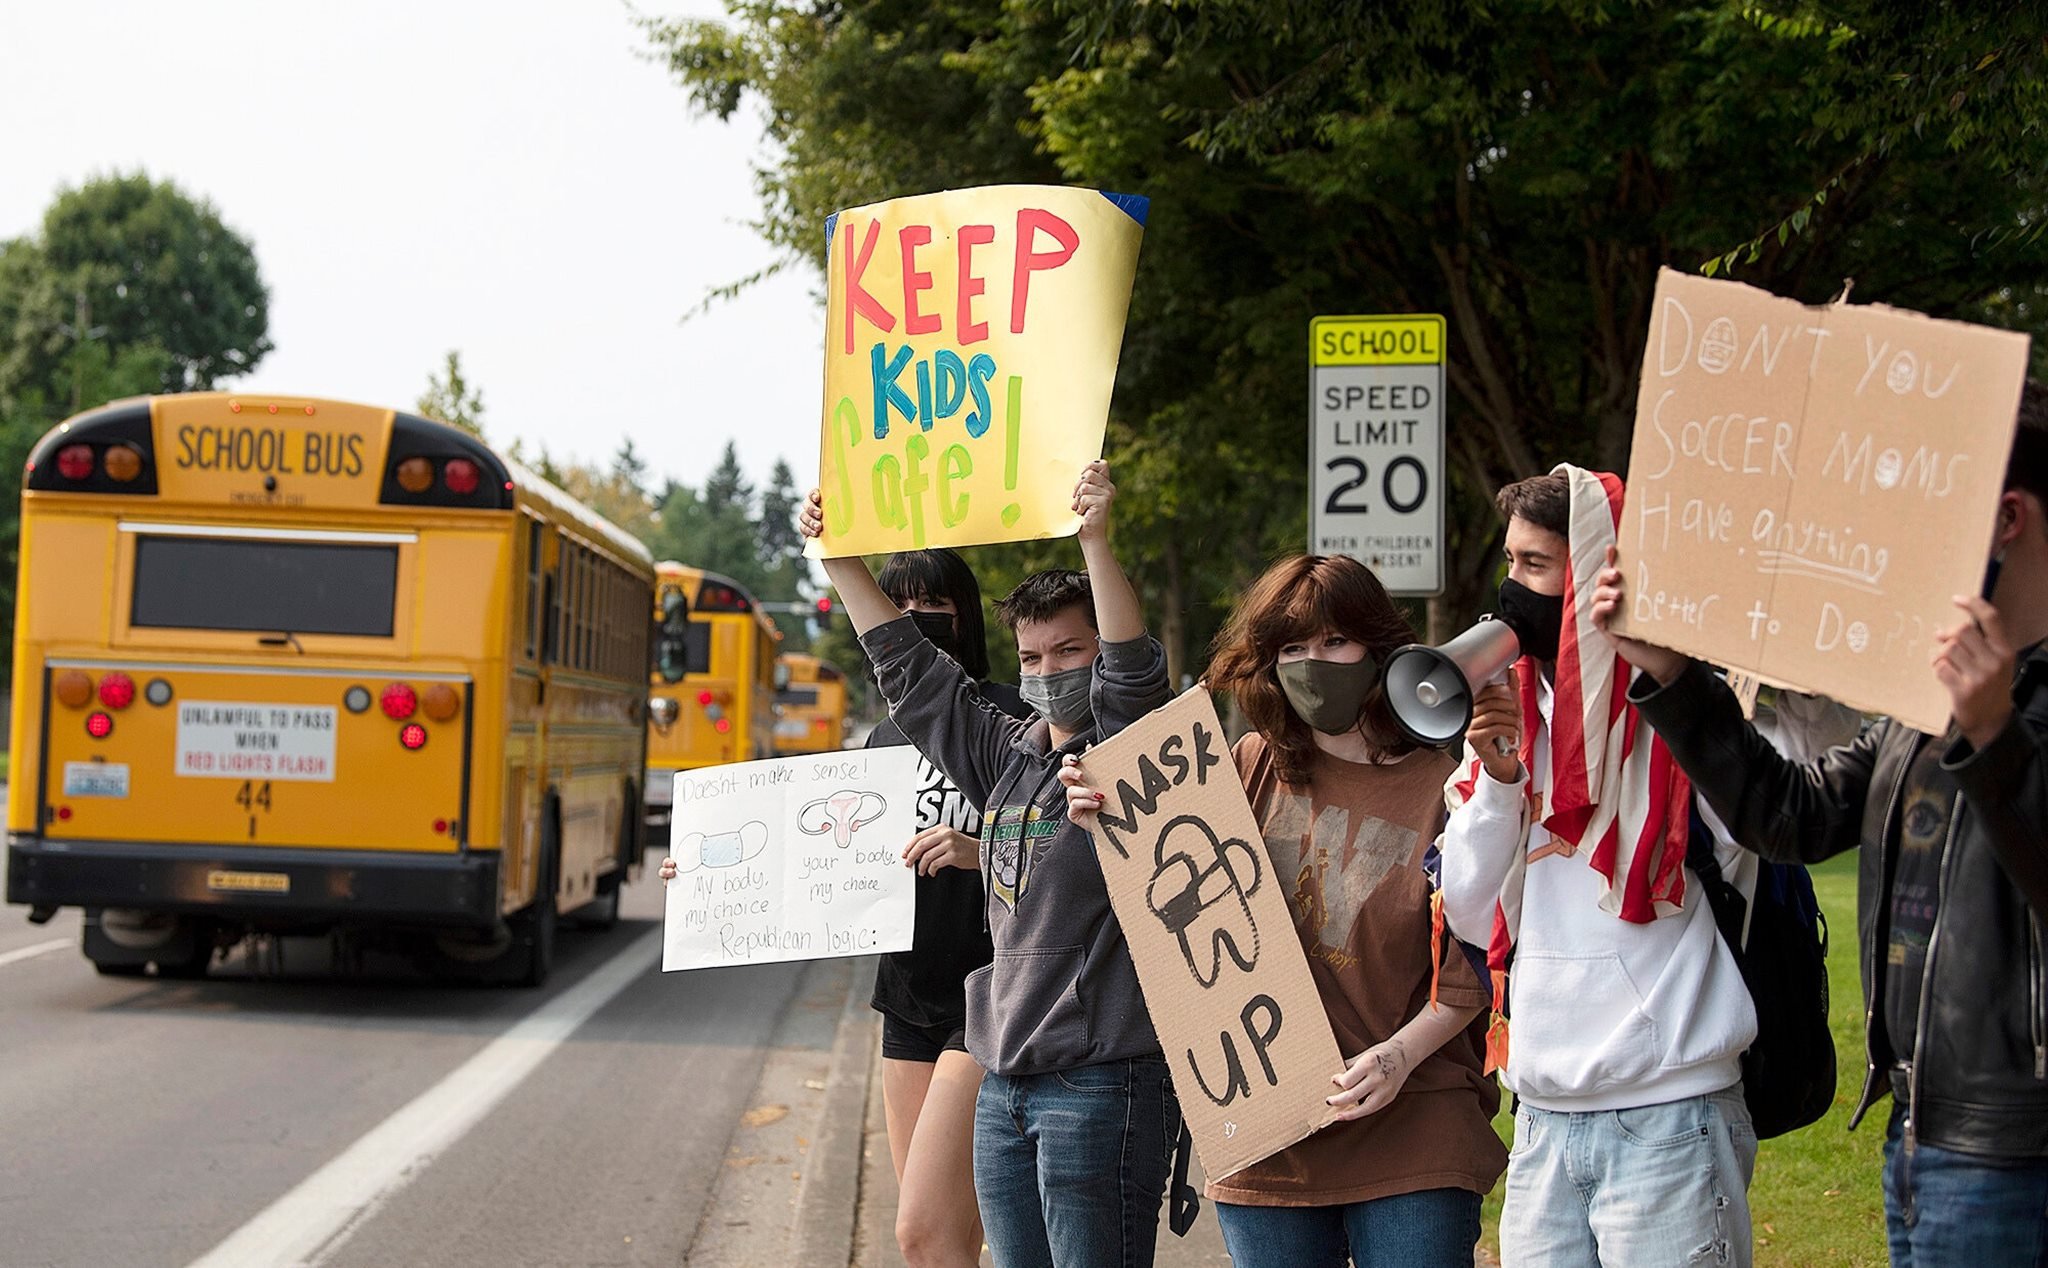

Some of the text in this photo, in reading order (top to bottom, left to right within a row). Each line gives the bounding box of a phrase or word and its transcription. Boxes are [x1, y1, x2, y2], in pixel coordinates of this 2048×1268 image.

[844, 208, 1080, 355] KEEP
[1322, 330, 1434, 356] SCHOOL
[1659, 296, 1960, 399] DON'T YOU
[870, 342, 997, 439] KIDS
[1324, 385, 1431, 410] SPEED
[176, 424, 364, 478] SCHOOL BUS
[1334, 420, 1420, 446] LIMIT
[1647, 388, 1970, 499] SOCCER MOMS
[1324, 454, 1428, 514] 20
[1321, 535, 1432, 550] WHEN CHILDREN
[1639, 486, 1890, 583] Have anything
[1633, 560, 1720, 631] Better
[1746, 600, 1782, 640] to
[182, 707, 333, 731] UNLAWFUL TO PASS
[235, 731, 280, 750] WHEN
[184, 751, 327, 775] RED LIGHTS FLASH
[749, 764, 796, 790] make
[813, 757, 868, 782] sense!
[235, 779, 272, 814] 44
[1098, 722, 1220, 860] MASK
[798, 845, 897, 880] your body,
[693, 866, 769, 910] My body,
[810, 884, 833, 905] my
[685, 898, 770, 933] my choice
[719, 922, 876, 960] Republican logic:
[1187, 993, 1283, 1108] UP
